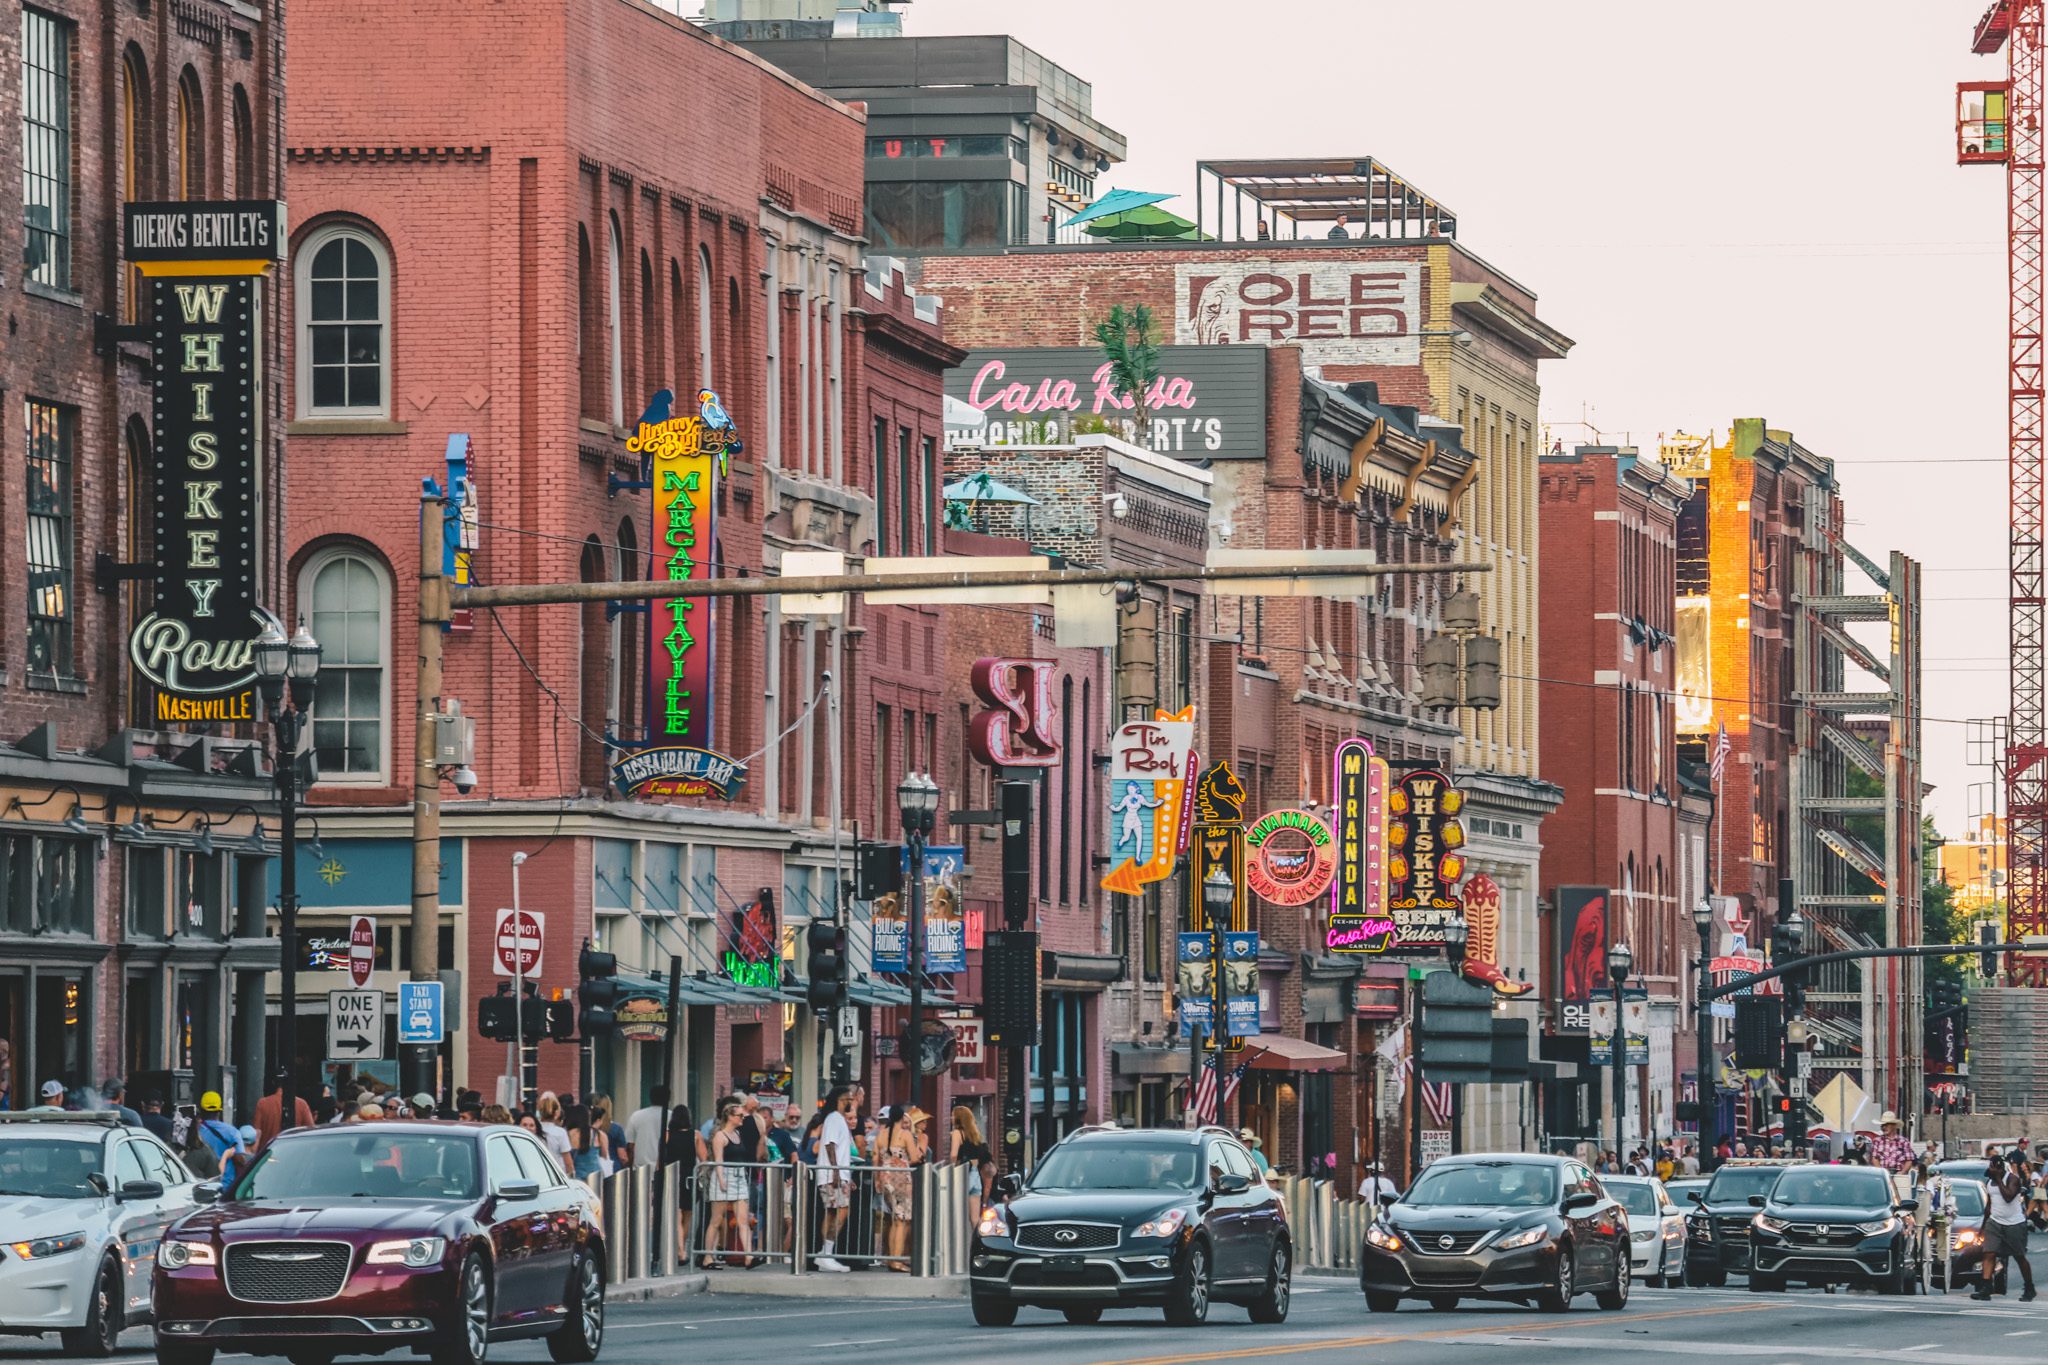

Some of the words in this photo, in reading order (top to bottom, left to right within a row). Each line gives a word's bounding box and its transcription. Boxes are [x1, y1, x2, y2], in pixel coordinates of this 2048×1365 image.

[132, 213, 187, 248] DIERKS
[192, 212, 268, 247] BENTLEY's
[1238, 272, 1407, 306] OLE
[1238, 307, 1408, 341] RED
[968, 359, 1082, 414] Casa
[626, 415, 701, 453] Jimmy
[174, 284, 229, 619] WHISKEY
[662, 470, 701, 734] MARGARTAVILLE
[143, 617, 257, 690] Row
[157, 691, 253, 721] NASHVILLE
[1122, 724, 1170, 749] Tin
[621, 751, 702, 783] RESTAURANT
[707, 757, 735, 786] BAR
[1121, 747, 1180, 778] Roof
[1183, 788, 1192, 818] MUSIC
[1179, 821, 1188, 849] JOINT
[1207, 825, 1228, 838] the
[1247, 811, 1330, 847] SAVANNAH'S
[1344, 754, 1361, 906] MIRANDA
[1369, 769, 1379, 909] LAMBERT'S
[1410, 779, 1438, 907] WHISKEY
[1247, 861, 1282, 902] CANDY
[1284, 861, 1332, 903] KITCHEN
[518, 924, 537, 936] NOT
[875, 917, 895, 935] BULL
[927, 917, 949, 935] BULL
[1392, 909, 1456, 926] BENT
[874, 934, 902, 952] RIDING
[927, 935, 958, 952] RIDING
[1327, 928, 1363, 947] Casa
[1361, 919, 1397, 940] Rosa
[1395, 924, 1446, 942] Saloo
[504, 951, 532, 964] ENER
[338, 995, 373, 1012] ONE
[408, 998, 433, 1010] STAND
[412, 985, 430, 997] TAXI
[336, 1014, 374, 1030] WAY
[1563, 1005, 1590, 1017] OL
[1563, 1016, 1590, 1028] RE
